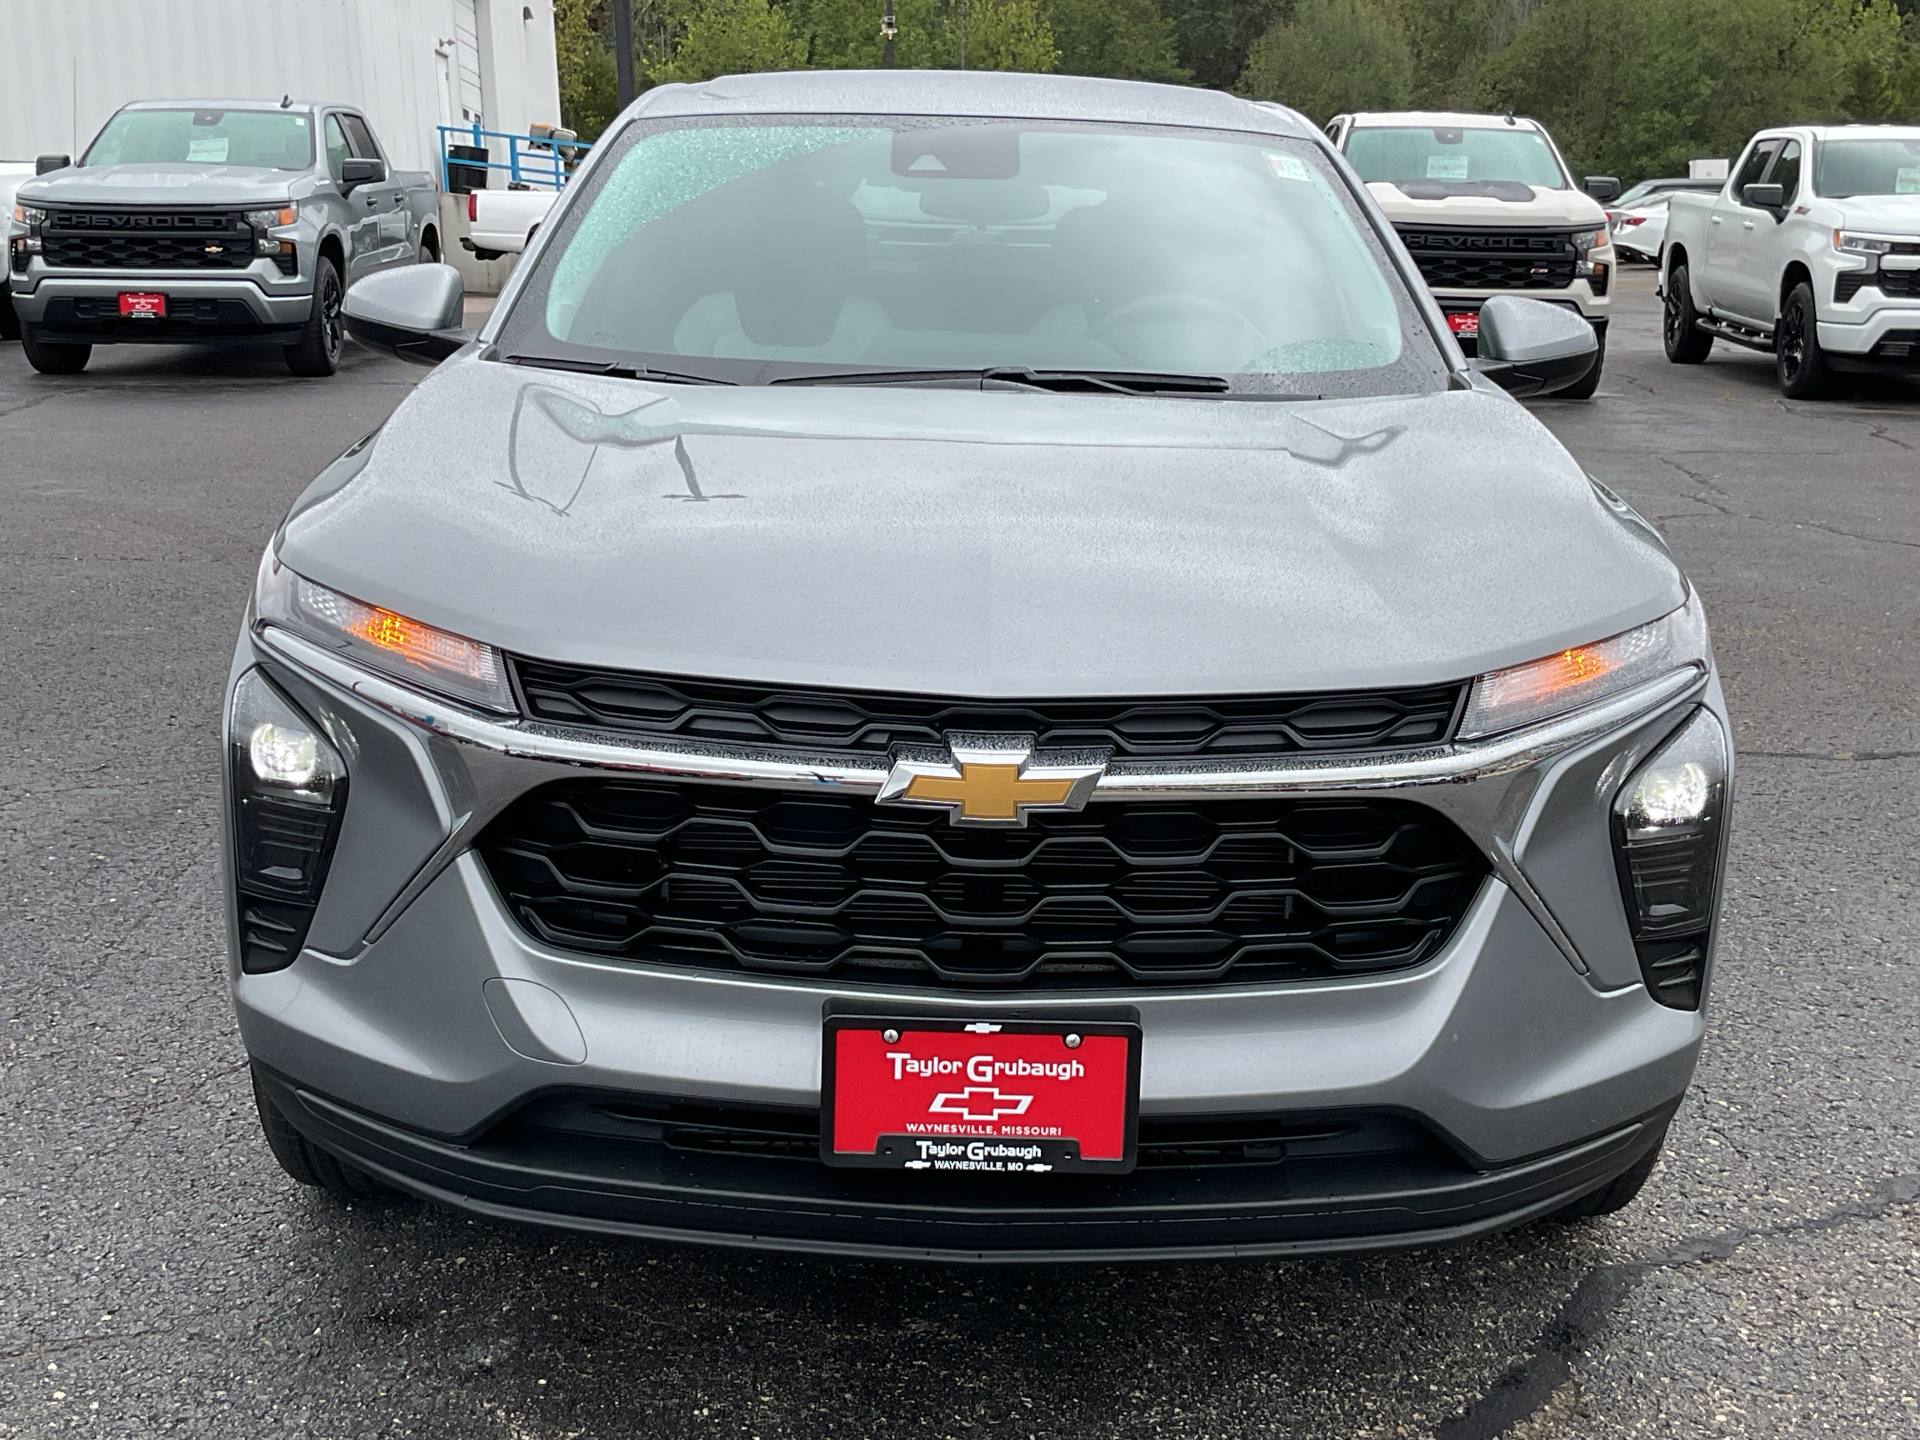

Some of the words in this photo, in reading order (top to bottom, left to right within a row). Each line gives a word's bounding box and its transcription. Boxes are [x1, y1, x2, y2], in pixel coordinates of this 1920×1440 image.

[53, 213, 234, 228] CHEVROLET
[1402, 233, 1565, 249] HEVROLET
[886, 1052, 963, 1080] Taylor
[966, 1055, 1084, 1082] Grubaugh
[906, 1123, 997, 1135] WAYNESVILLE,
[1001, 1126, 1062, 1136] MISSOURI
[916, 1140, 965, 1160] Taylor
[967, 1142, 1042, 1161] Grubaugh
[934, 1160, 1005, 1172] WAYNESVILLE,
[1007, 1162, 1024, 1172] MO
